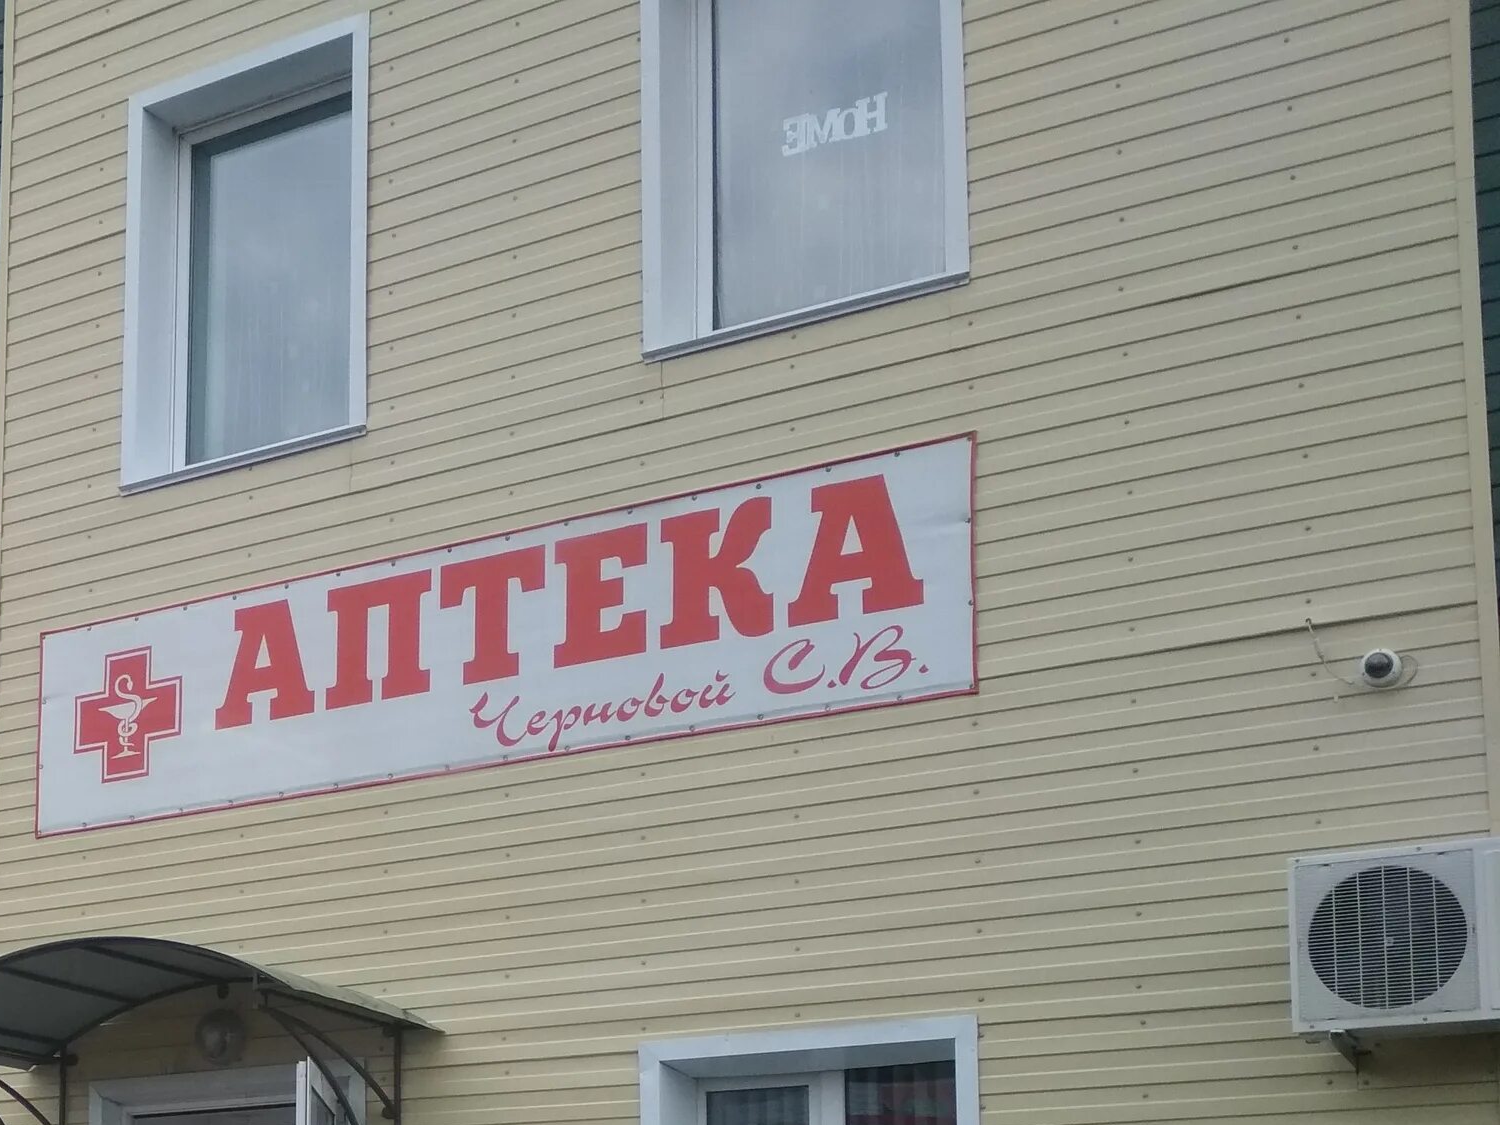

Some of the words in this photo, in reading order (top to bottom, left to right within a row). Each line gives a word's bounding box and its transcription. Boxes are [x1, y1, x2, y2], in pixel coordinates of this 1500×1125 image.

[214, 474, 925, 730] АПТЕКА
[468, 671, 736, 752] Черновой
[760, 624, 931, 694] С.В.
